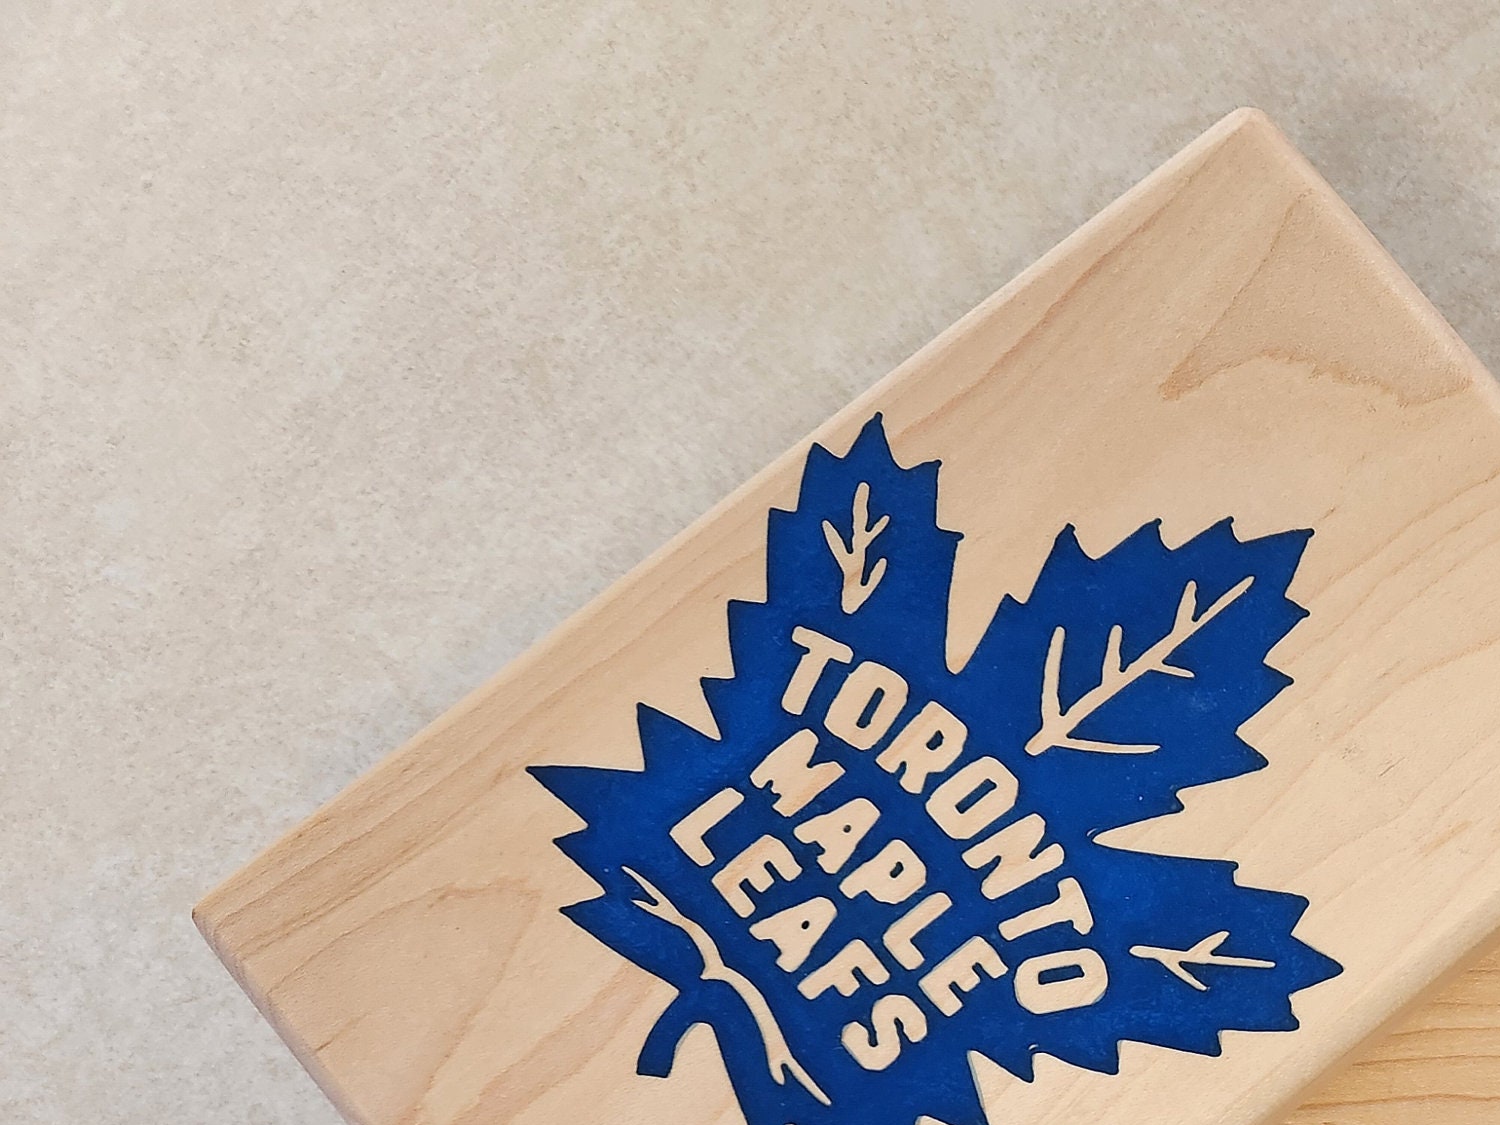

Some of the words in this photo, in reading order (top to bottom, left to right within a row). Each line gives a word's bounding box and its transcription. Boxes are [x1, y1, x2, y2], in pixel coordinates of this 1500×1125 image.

[669, 787, 928, 1070] LEAFS
[749, 728, 1008, 1017] MAPLE
[782, 626, 1108, 1014] TORONTO
